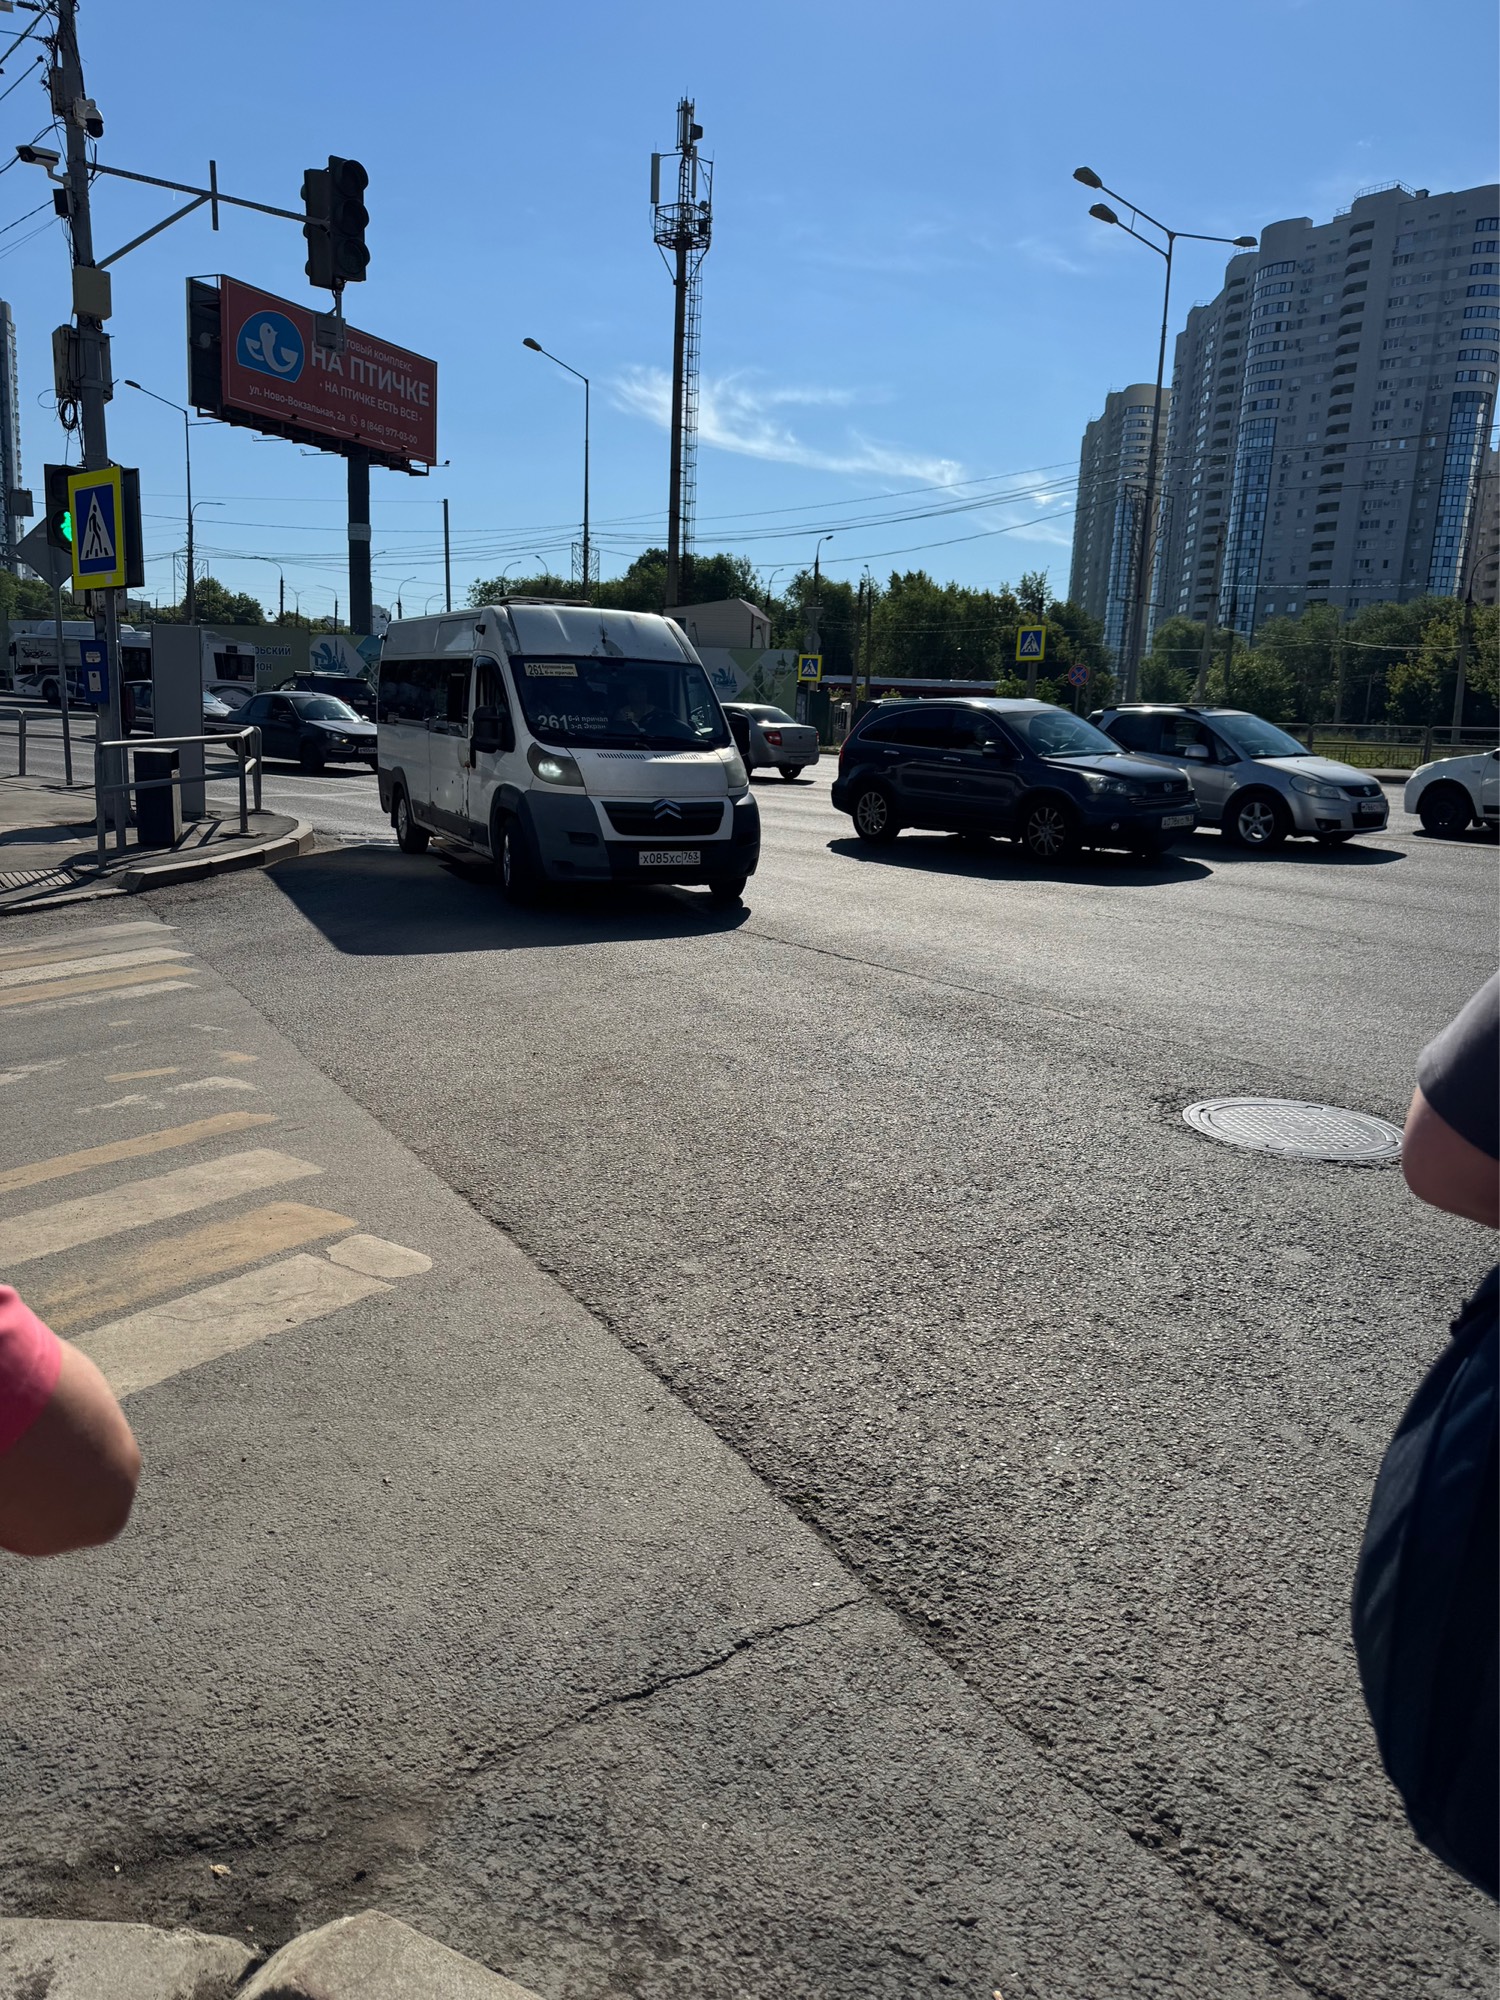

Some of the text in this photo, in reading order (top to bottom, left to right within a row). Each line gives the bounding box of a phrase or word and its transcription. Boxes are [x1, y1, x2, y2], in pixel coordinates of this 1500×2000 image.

[311, 340, 430, 407] НА ПТИЧКЕ
[249, 385, 262, 396] ул.
[337, 411, 346, 422] 2а
[324, 380, 419, 422] НА ПТИЧКЕ ЕСТЬ ВСЕ!
[360, 418, 366, 428] 8
[366, 420, 385, 435] (846)
[527, 664, 544, 676] 261
[537, 714, 568, 730] 261
[684, 852, 699, 860] 763
